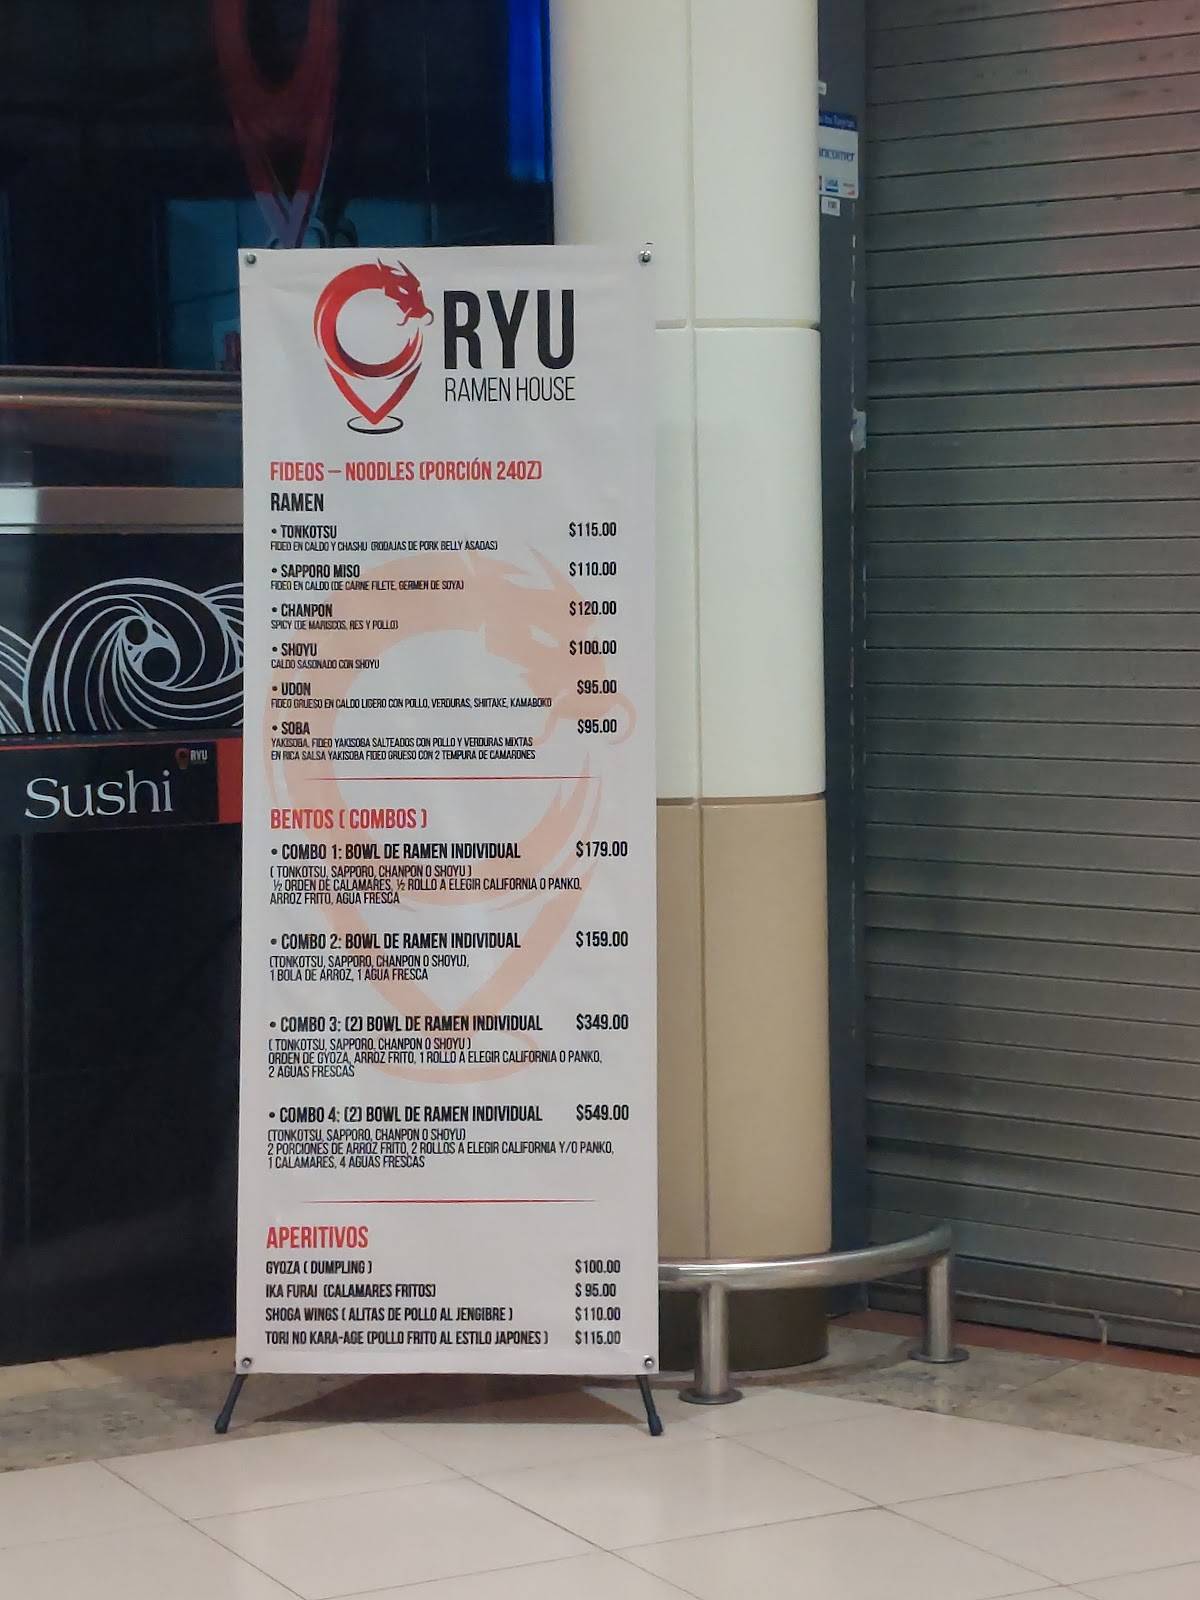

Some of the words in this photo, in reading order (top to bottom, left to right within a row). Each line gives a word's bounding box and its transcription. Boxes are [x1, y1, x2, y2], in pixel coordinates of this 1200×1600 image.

[443, 290, 575, 370] RYU
[444, 376, 511, 402] RAMEN
[516, 376, 576, 402] HOUSE
[270, 461, 324, 482] FIDEOS
[345, 461, 414, 481] NOODLES
[270, 492, 325, 513] RAMEN
[280, 525, 338, 539] TONKOTSU
[568, 521, 617, 538] $115.00
[280, 564, 330, 578] SAPPORO
[333, 564, 361, 578] MISO
[568, 561, 617, 578] $110.00
[280, 603, 333, 617] CHANPON
[568, 601, 617, 617] $120.00
[280, 643, 317, 657] SHOYU
[568, 640, 617, 656] $100.00
[280, 682, 311, 696] UDON
[576, 679, 617, 695] $95.00
[280, 721, 310, 735] SOBA
[577, 719, 618, 734] $95.00
[190, 750, 208, 761] RYU
[25, 769, 174, 819] Sushi
[270, 808, 333, 829] BENTOS
[349, 808, 417, 829] COMBOS
[281, 843, 327, 860] COMBO
[345, 843, 380, 859] BOWL
[384, 843, 399, 859] DE
[403, 843, 448, 859] RAMEN
[451, 842, 521, 859] INDIVIDUAL
[575, 840, 628, 858] $179.00
[378, 865, 423, 878] CHANPON
[434, 864, 466, 877] SHOYU
[284, 879, 316, 892] ORDEN
[407, 878, 437, 892] ROLLO
[448, 878, 481, 892] ELEGIR
[483, 878, 537, 891] CALIFORNIA
[269, 892, 302, 905] ARROZ
[336, 892, 361, 905] AGUA
[363, 892, 400, 905] FRESCA
[281, 934, 326, 950] COMBO
[345, 933, 380, 950] BOWL
[384, 933, 399, 949] DE
[403, 933, 448, 949] RAMEN
[451, 932, 521, 949] INDIVIDUAL
[575, 931, 629, 948] $159.00
[376, 955, 421, 968] CHANPON
[277, 969, 302, 982] BOLA
[364, 968, 389, 981] AGUA
[392, 968, 429, 981] FRESCA
[280, 1016, 325, 1033] COMBO
[367, 1015, 401, 1032] BOWL
[405, 1015, 420, 1032] DE
[424, 1015, 469, 1032] RAMEN
[473, 1015, 543, 1032] INDIVIDUAL
[575, 1014, 629, 1031] $349.00
[268, 1052, 300, 1065] ORDEN
[354, 1051, 385, 1065] ARROZ
[426, 1051, 457, 1064] ROLLO
[467, 1051, 500, 1064] ELEGIR
[502, 1051, 557, 1064] CALIFORNIA
[277, 1065, 310, 1078] AGUAS
[311, 1065, 355, 1078] FRESCAS
[279, 1107, 325, 1123] COMBO
[366, 1107, 401, 1123] BOWL
[404, 1106, 420, 1123] DE
[424, 1106, 469, 1123] RAMEN
[472, 1106, 543, 1122] INDIVIDUAL
[575, 1105, 630, 1122] $549.00
[276, 1142, 329, 1156] PORCIONES
[346, 1142, 378, 1155] ARROZ
[419, 1142, 456, 1155] ROLLOS
[467, 1142, 499, 1155] ELEGIR
[501, 1142, 556, 1155] CALIFORNIA
[559, 1141, 578, 1155] Y/O
[349, 1155, 381, 1168] AGUAS
[383, 1155, 425, 1168] FRESCAS
[266, 1226, 369, 1249] APERITIVOS
[265, 1260, 300, 1275] GYOZA
[310, 1260, 365, 1275] DUMPLING
[575, 1259, 621, 1274] $100.00
[265, 1284, 283, 1299] IKA
[286, 1284, 318, 1298] FURAI
[265, 1307, 301, 1322] SHOGA
[304, 1307, 338, 1322] WINGS
[349, 1307, 385, 1322] ALITAS
[388, 1307, 401, 1322] DE
[404, 1307, 437, 1321] POLLO
[440, 1307, 452, 1321] AL
[457, 1306, 505, 1321] JENGIBRE
[575, 1306, 621, 1322] $110.00
[265, 1331, 289, 1345] TORI
[292, 1331, 307, 1345] NO
[309, 1331, 364, 1345] KARA-AGE
[407, 1330, 437, 1345] FRITO
[440, 1330, 453, 1345] AL
[455, 1330, 492, 1345] ESTILO
[495, 1330, 541, 1345] JAPONES
